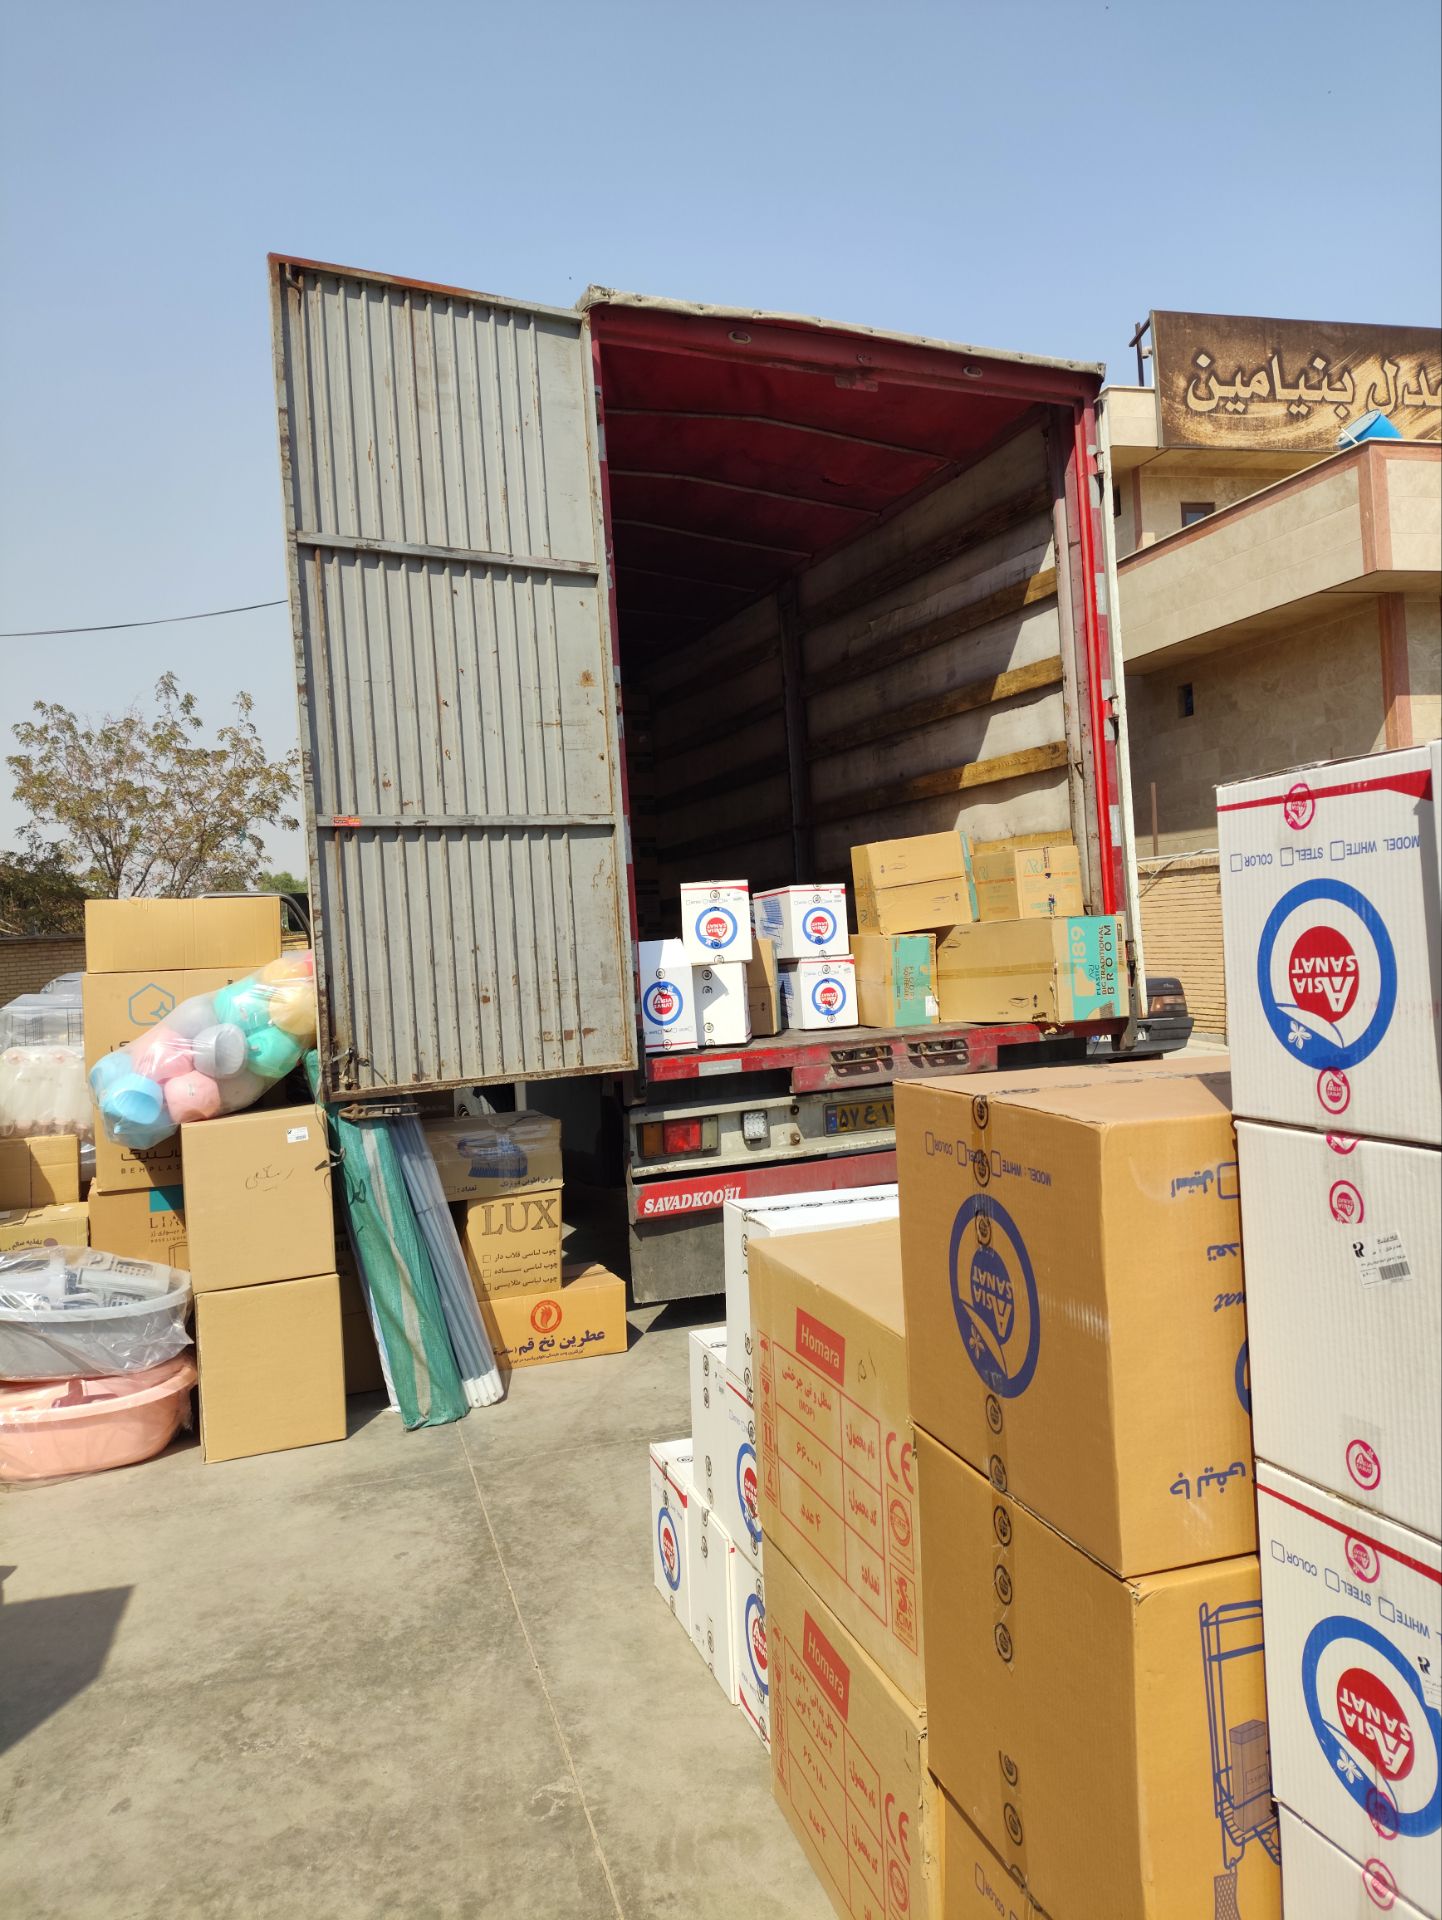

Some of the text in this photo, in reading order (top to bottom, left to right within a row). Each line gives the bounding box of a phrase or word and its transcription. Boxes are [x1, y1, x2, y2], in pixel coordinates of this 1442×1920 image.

[1187, 354, 1354, 418] بنیامین
[1244, 835, 1421, 867] MODEL WHITE STEEL COLOR
[1104, 925, 1115, 995] BROOM
[1291, 955, 1357, 975] SANAT
[1293, 976, 1356, 1012] ASIA
[481, 1198, 559, 1236] LUX
[644, 1186, 742, 1215] SAVADKOOHI
[973, 1266, 1015, 1295] SANAT
[974, 1281, 1013, 1337] ASIA
[518, 1337, 535, 1356] قم
[538, 1335, 555, 1352] نخ
[560, 1329, 605, 1350] عطرین
[801, 1324, 840, 1368] Homara
[885, 1431, 914, 1495] CE
[1285, 1551, 1318, 1577] COLOR
[1340, 1579, 1372, 1606] STEEL
[1395, 1608, 1430, 1639] WHITE
[808, 1631, 845, 1700] Homara
[1340, 1687, 1412, 1734] SANAT
[1343, 1711, 1409, 1775] ASIA
